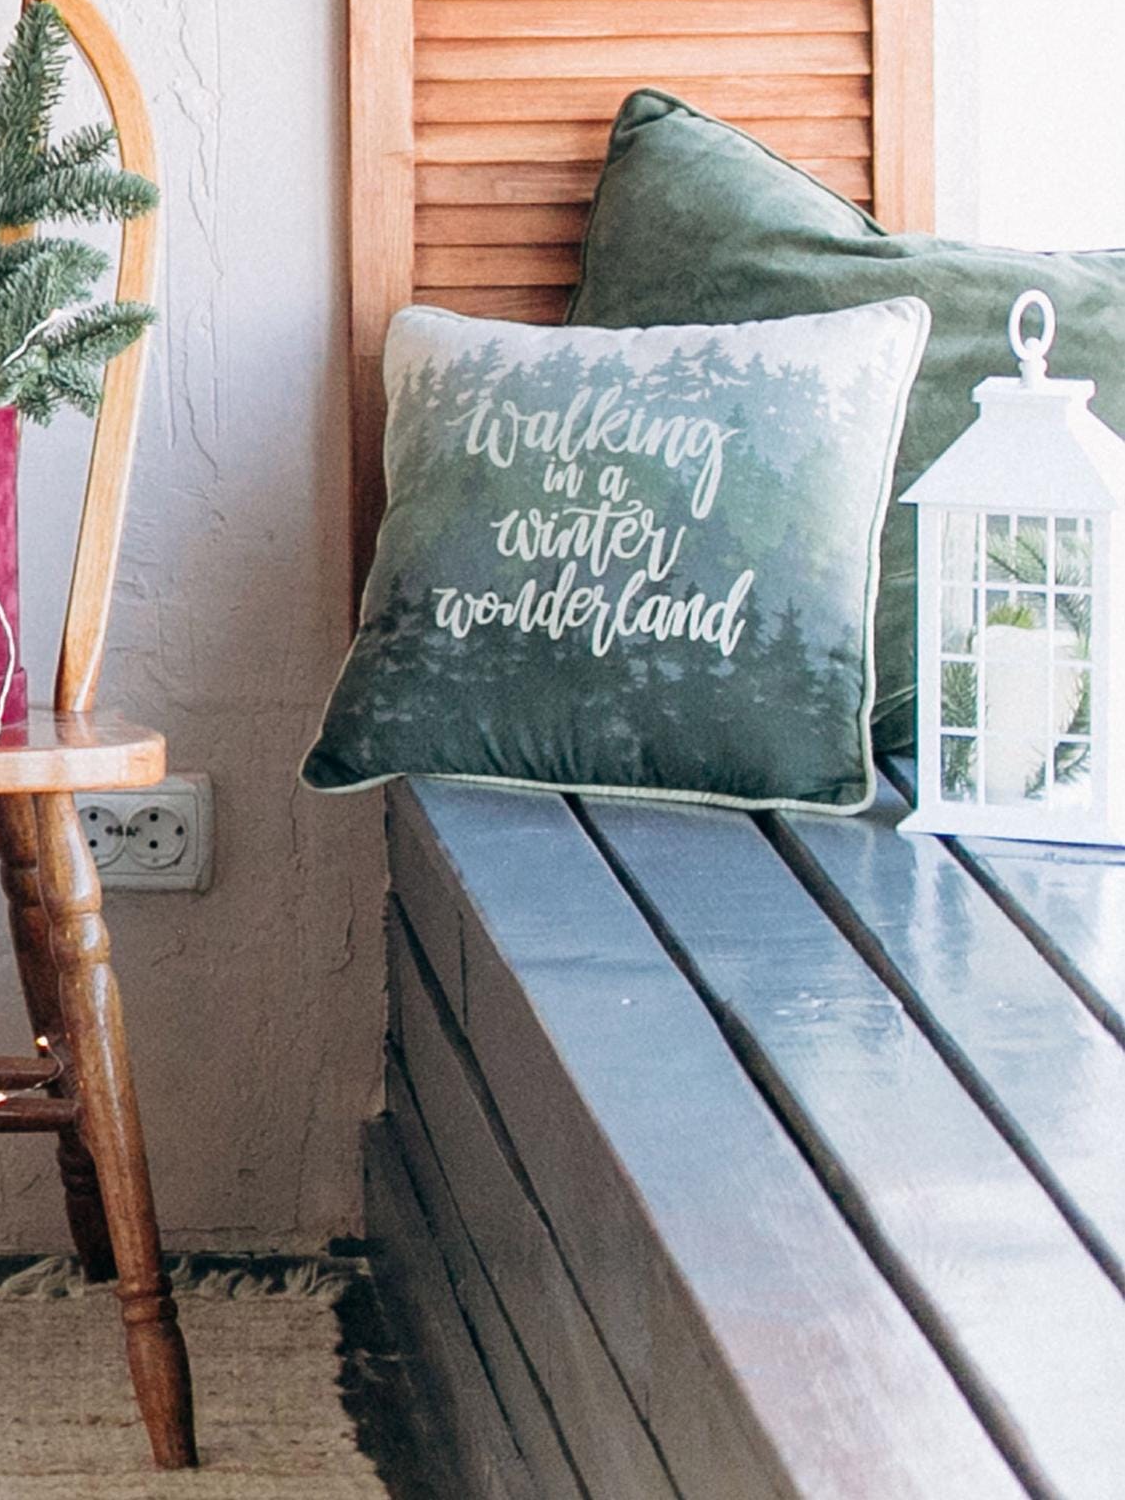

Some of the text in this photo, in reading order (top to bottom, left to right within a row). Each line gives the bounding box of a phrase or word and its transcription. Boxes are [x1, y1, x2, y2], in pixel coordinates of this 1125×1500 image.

[542, 456, 630, 501] in a
[490, 500, 687, 582] winter
[432, 561, 754, 657] wonderland
